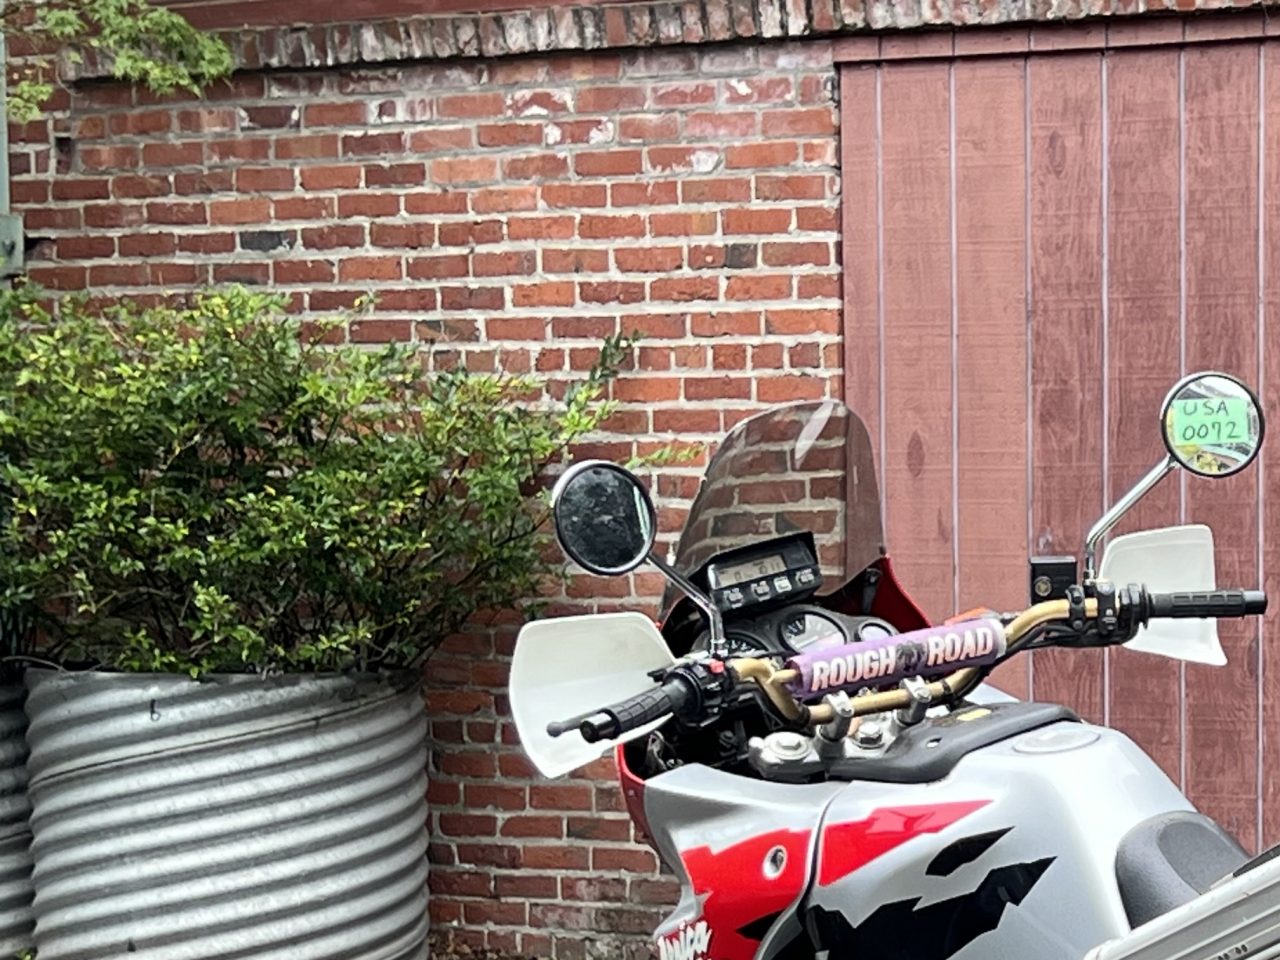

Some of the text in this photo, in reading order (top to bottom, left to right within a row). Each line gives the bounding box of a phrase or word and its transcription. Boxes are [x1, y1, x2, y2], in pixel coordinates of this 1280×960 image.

[1183, 399, 1230, 417] USA
[1182, 421, 1241, 441] 0072
[811, 627, 994, 692] ROUGH ROAD
